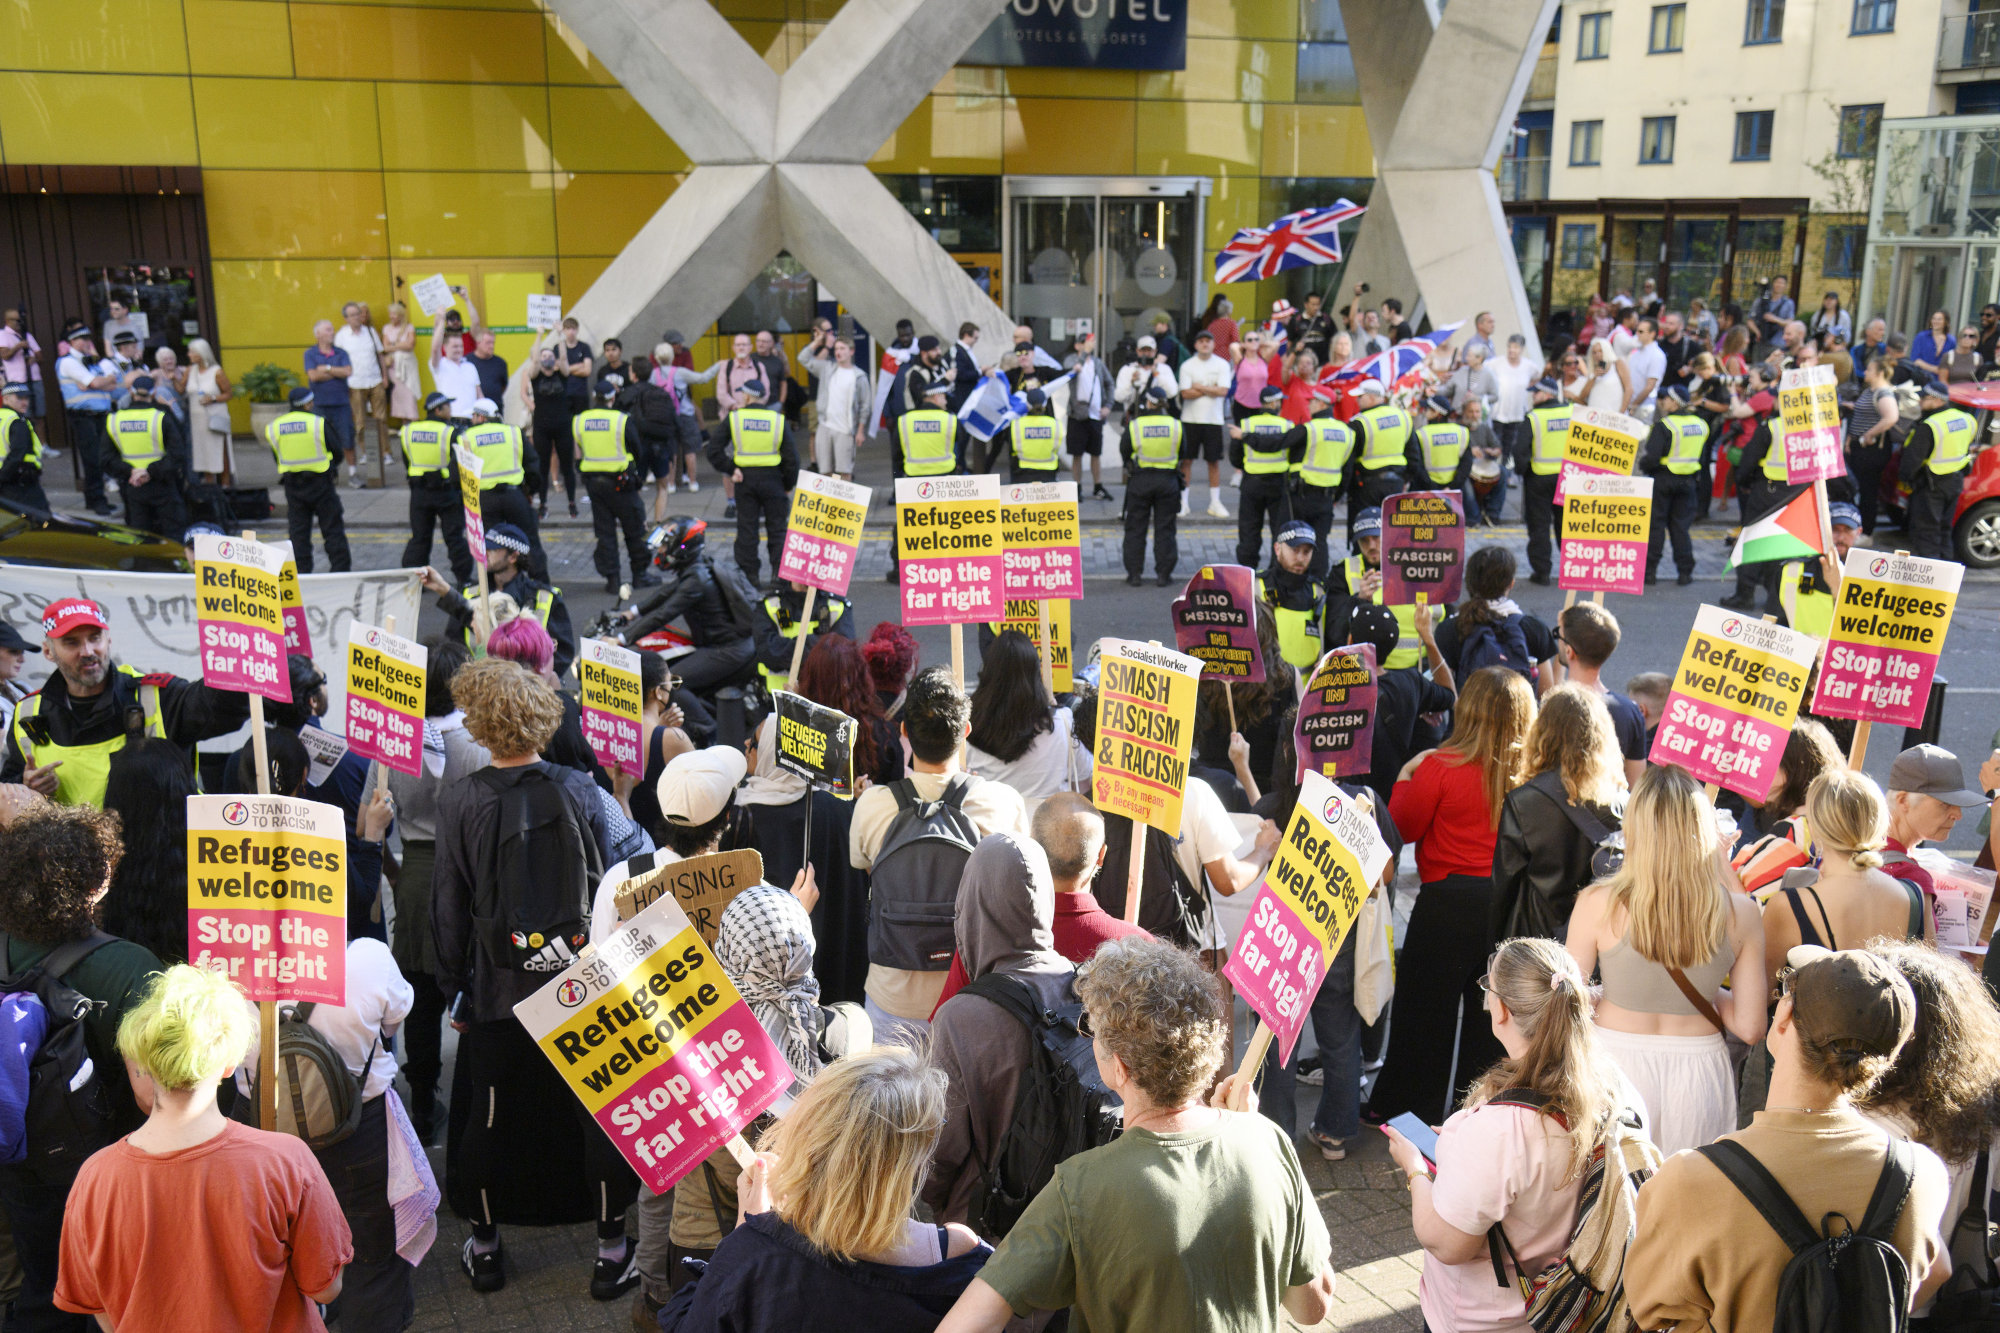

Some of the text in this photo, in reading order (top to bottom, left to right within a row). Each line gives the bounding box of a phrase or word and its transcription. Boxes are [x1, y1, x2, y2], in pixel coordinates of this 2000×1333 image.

[1000, 0, 1171, 22] OVOTEL
[1003, 31, 1147, 46] HOTELS & RESORTS
[120, 421, 147, 432] POLICE
[280, 422, 306, 434] POLICE
[412, 432, 437, 443] POLICE
[585, 419, 610, 431] POLICE
[744, 420, 770, 431] POLICE
[914, 421, 940, 432] POLICE
[1025, 428, 1051, 438] POLICE
[1144, 426, 1169, 437] POLICE
[477, 433, 505, 446] POLICE
[1434, 434, 1458, 445] POLICE
[1571, 425, 1635, 454] Refugees
[1569, 445, 1629, 469] welcome
[1790, 454, 1810, 471] far
[936, 480, 974, 490] STAND UP
[936, 489, 979, 498] TO RACISM
[797, 493, 862, 523] Refugees
[903, 507, 996, 529] Refugees
[1002, 508, 1075, 526] Refugees
[1400, 499, 1447, 512] BLACK
[1569, 498, 1647, 518] Refugees
[795, 514, 855, 539] welcome
[1392, 513, 1457, 526] LIBERATION
[1568, 519, 1641, 535] welcome
[905, 531, 993, 551] welcome
[1002, 527, 1073, 543] welcome
[1414, 528, 1434, 540] IN!
[788, 533, 848, 563] Stop the
[1004, 551, 1072, 571] Stop the
[1393, 551, 1453, 562] FASCISM
[1565, 541, 1637, 564] Stop the
[784, 551, 806, 570] far
[808, 560, 843, 581] right
[905, 561, 992, 587] Stop the
[1406, 566, 1439, 578] OUT!
[1563, 561, 1635, 583] far right
[1890, 570, 1935, 585] TO RACISM
[1891, 560, 1933, 573] STAND UP
[203, 566, 278, 600] Refugees
[1005, 570, 1073, 590] far right
[58, 604, 93, 619] POLICE
[203, 594, 276, 624] welcome
[906, 586, 991, 612] far right
[1196, 594, 1228, 607] OUT!
[1845, 583, 1948, 618] Refugees
[1185, 611, 1243, 624] FASCISM
[1840, 614, 1934, 644] welcome
[204, 625, 249, 654] Stop
[253, 632, 278, 658] the
[1742, 633, 1794, 657] TO RACISM
[1744, 623, 1793, 643] STAND UP
[206, 650, 279, 683] far right
[353, 648, 422, 689] Refugees
[1120, 645, 1188, 673] Socialist Worker
[1691, 638, 1802, 693] Refugees
[1830, 646, 1921, 680] Stop the
[352, 674, 418, 709] welcome
[585, 664, 639, 695] Refugees
[1105, 661, 1171, 705] SMASH
[1823, 674, 1913, 709] far right
[586, 688, 638, 714] welcome
[1684, 669, 1788, 717] welcome
[350, 697, 414, 738] Stop the
[586, 711, 638, 743] Stop the
[1101, 698, 1180, 748] FASCISM
[1305, 714, 1364, 731] FASCISM
[1669, 699, 1772, 752] Stop the
[349, 719, 374, 743] far
[376, 731, 412, 760] right
[780, 715, 827, 752] REFUGEES
[1315, 732, 1349, 747] OUT!
[585, 731, 638, 764] far right
[780, 733, 825, 770] WELCOME
[1660, 725, 1698, 755] far
[1700, 742, 1762, 779] right
[1098, 737, 1185, 790] & RACISM
[1113, 795, 1151, 819] necessary
[1114, 780, 1165, 809] By any means
[252, 803, 310, 816] STAND UP
[252, 816, 316, 831] TO RACISM
[1343, 807, 1375, 846] STAND UP
[198, 836, 340, 873] Refugees
[1338, 822, 1371, 868] TO RACISM
[1289, 814, 1359, 920] Refugees
[197, 872, 333, 904] welcome
[1276, 855, 1341, 951] welcome
[197, 916, 329, 950] Stop the
[621, 926, 640, 948] UP
[1254, 895, 1298, 964] Stop
[1297, 944, 1320, 996] the
[198, 950, 328, 984] far right
[1238, 929, 1271, 977] far
[1267, 970, 1304, 1031] right
[589, 974, 610, 992] TO
[552, 944, 704, 1066] Refugees
[581, 983, 719, 1094] welcome
[611, 1072, 691, 1136] Stop
[686, 1028, 745, 1079] the
[634, 1055, 766, 1169] far right
